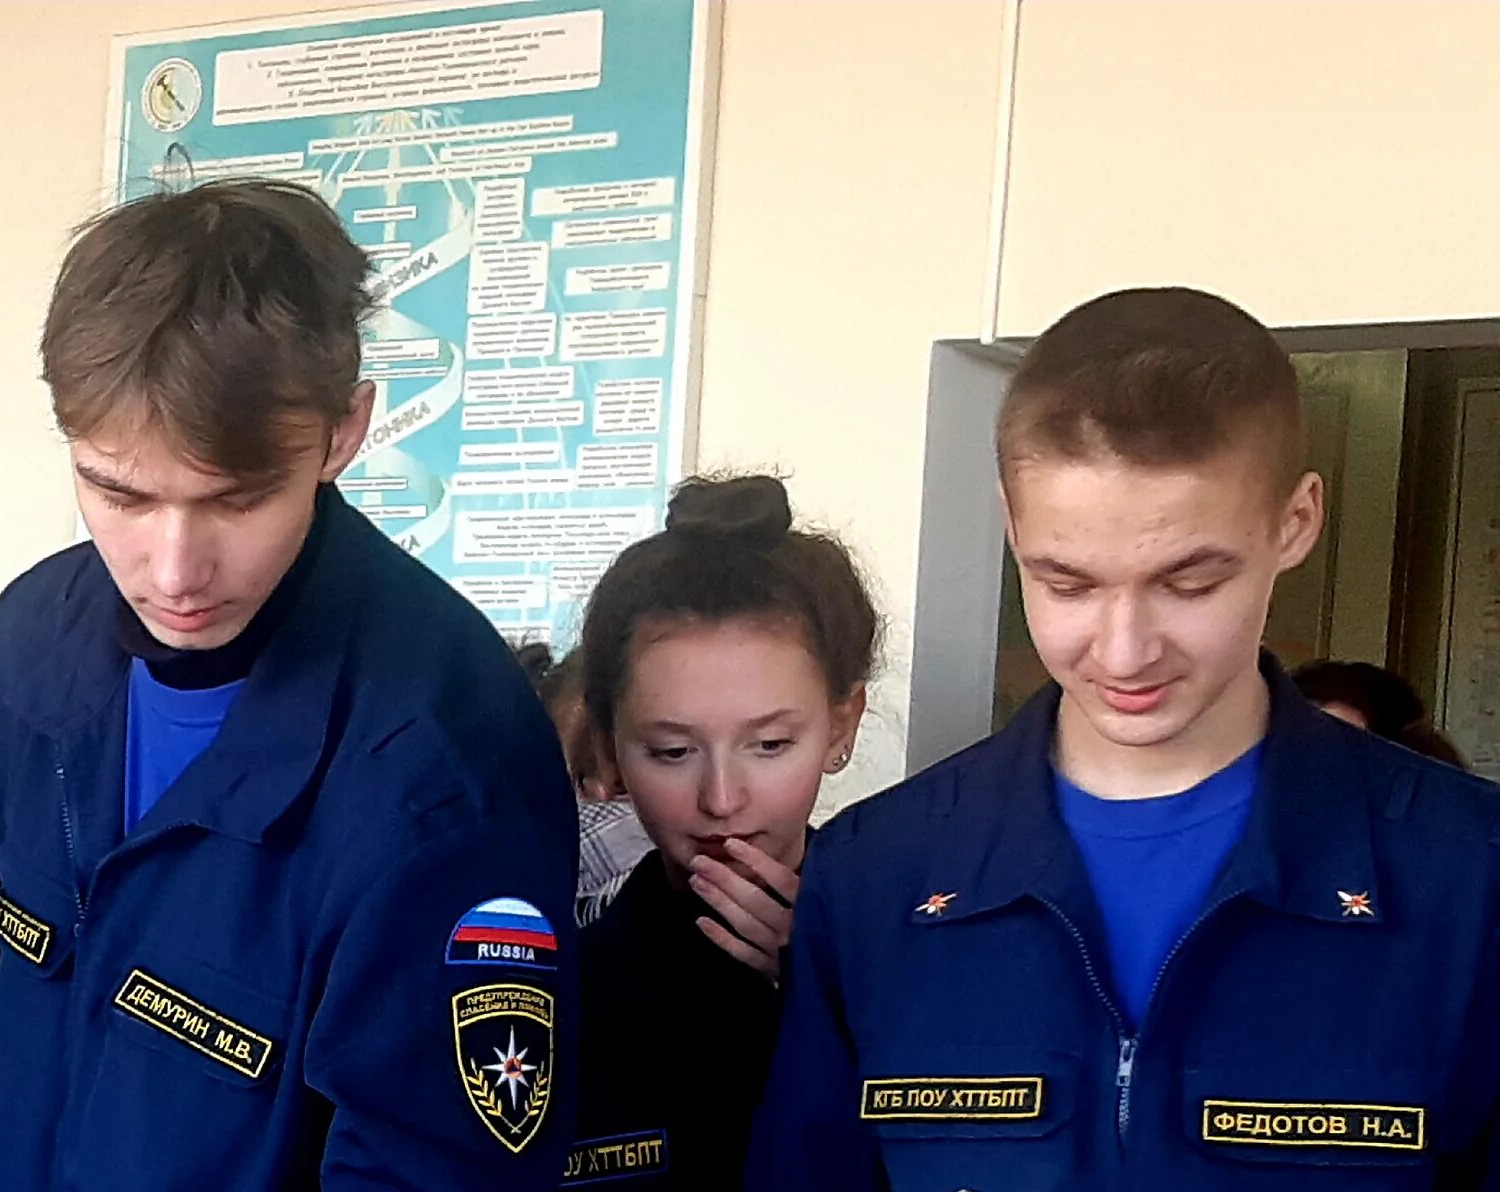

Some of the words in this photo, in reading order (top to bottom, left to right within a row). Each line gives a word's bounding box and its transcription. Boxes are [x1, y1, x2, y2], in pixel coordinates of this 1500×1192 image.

[477, 942, 536, 961] RUSSIA
[127, 983, 210, 1040] ДЕМУРИН
[213, 1029, 254, 1065] М.В.
[873, 1089, 904, 1108] КГБ
[907, 1088, 948, 1107] ПОУ
[950, 1087, 1029, 1108] ХТТБПТ
[1213, 1112, 1347, 1137] ФЕДОТОВ
[1362, 1115, 1412, 1138] Н.А.
[588, 1139, 662, 1173] ХТТБПТ
